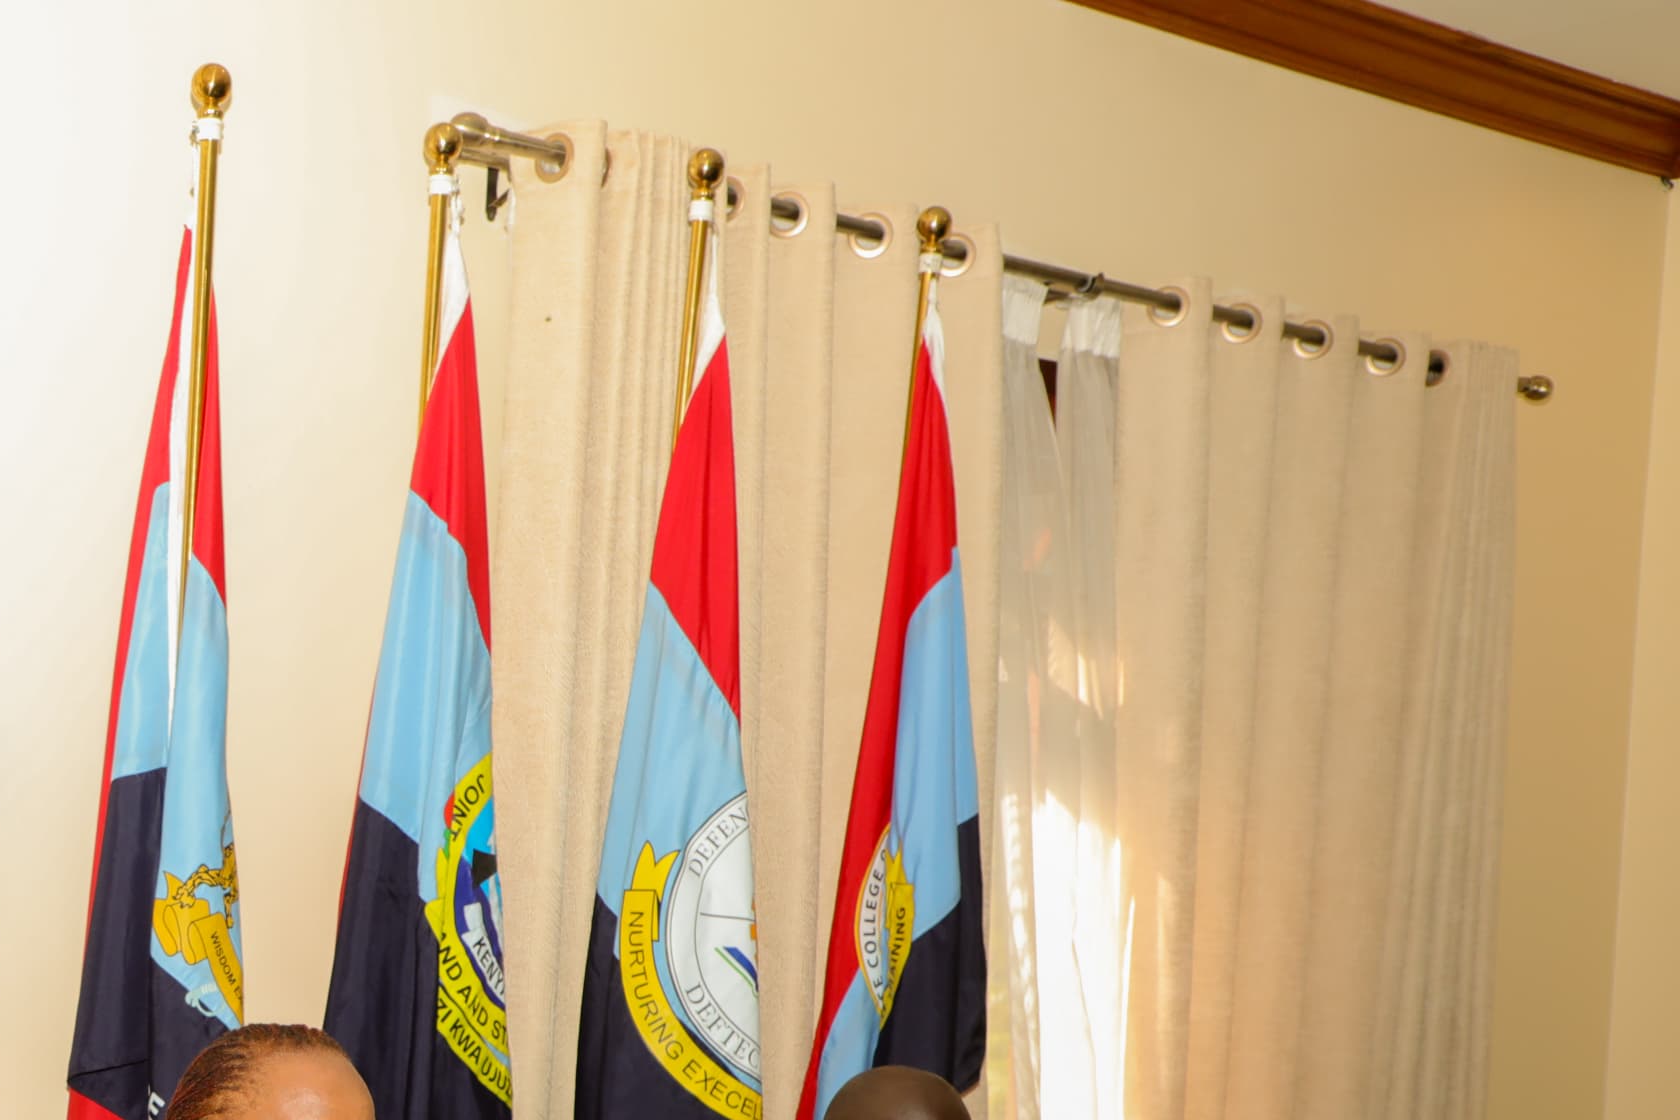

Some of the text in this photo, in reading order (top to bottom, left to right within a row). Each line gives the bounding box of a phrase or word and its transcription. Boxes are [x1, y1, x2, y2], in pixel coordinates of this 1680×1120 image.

[450, 773, 485, 842] JOINT
[863, 868, 883, 968] COLLEGE
[210, 932, 236, 985] WISDOM
[628, 910, 684, 1061] NURTURING
[457, 984, 489, 1027] AND
[449, 1019, 481, 1065] KWA
